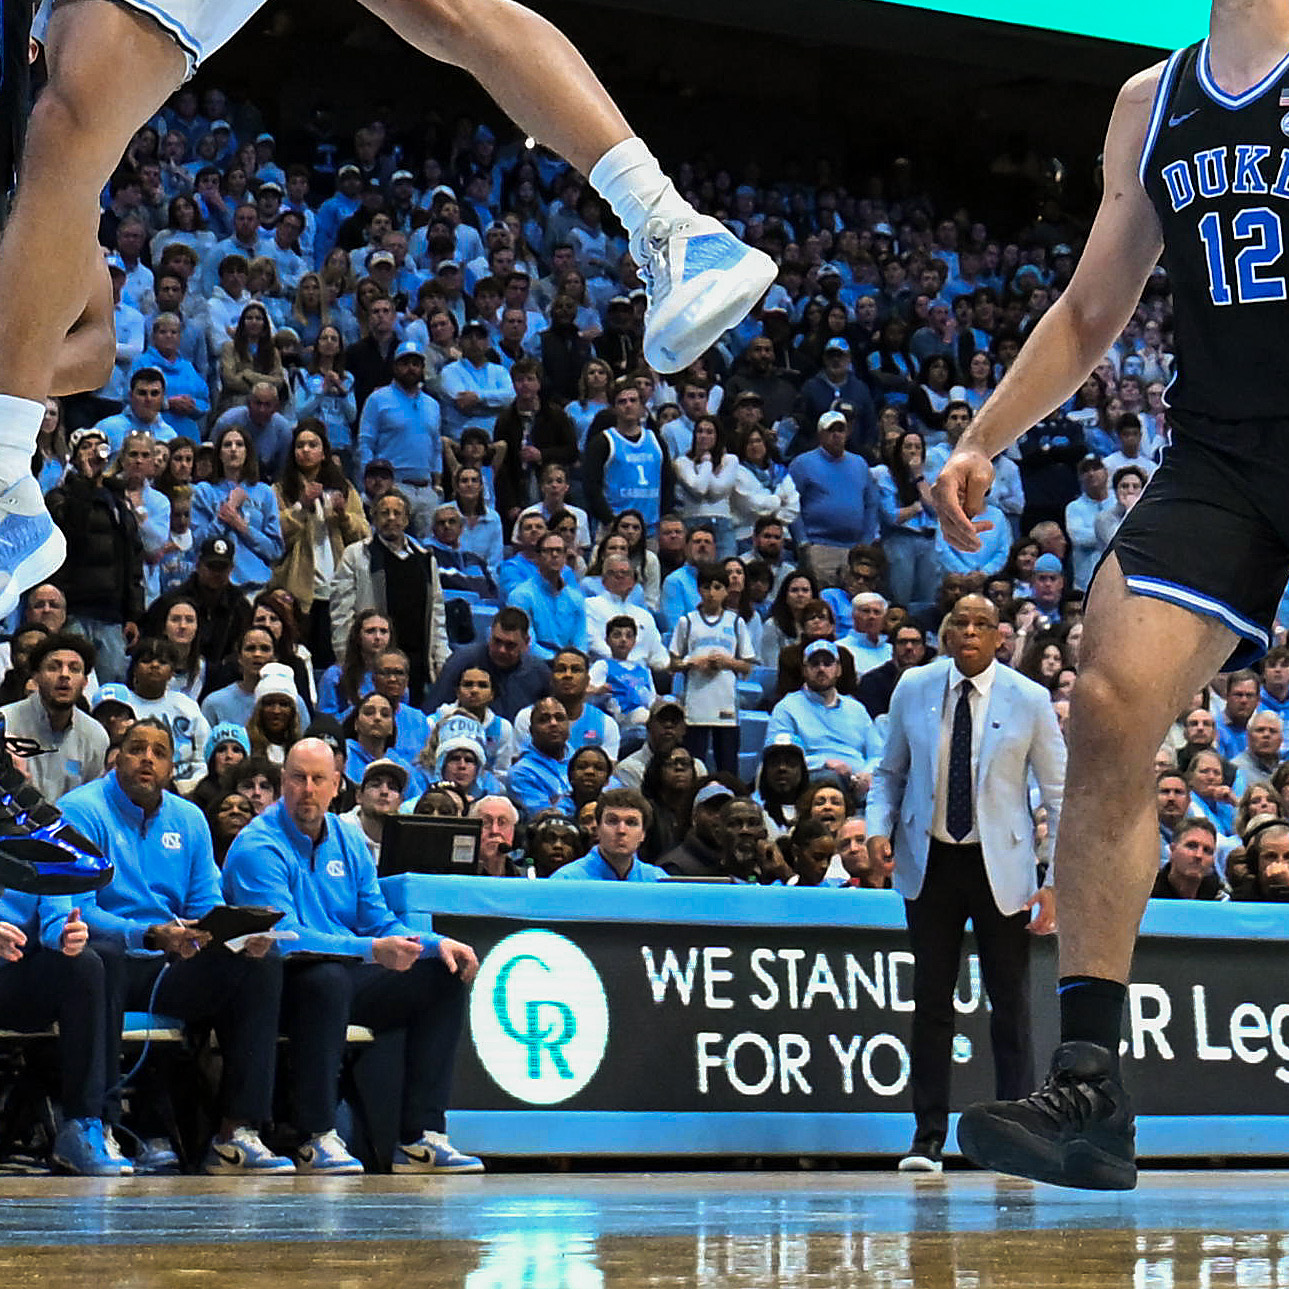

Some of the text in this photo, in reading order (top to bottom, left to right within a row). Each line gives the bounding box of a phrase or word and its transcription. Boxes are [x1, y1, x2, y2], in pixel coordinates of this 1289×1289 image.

[1198, 207, 1288, 306] 12
[212, 728, 240, 743] UNC
[641, 945, 993, 1014] WE STAND U
[1118, 983, 1175, 1061] R
[696, 1031, 813, 1096] FOR
